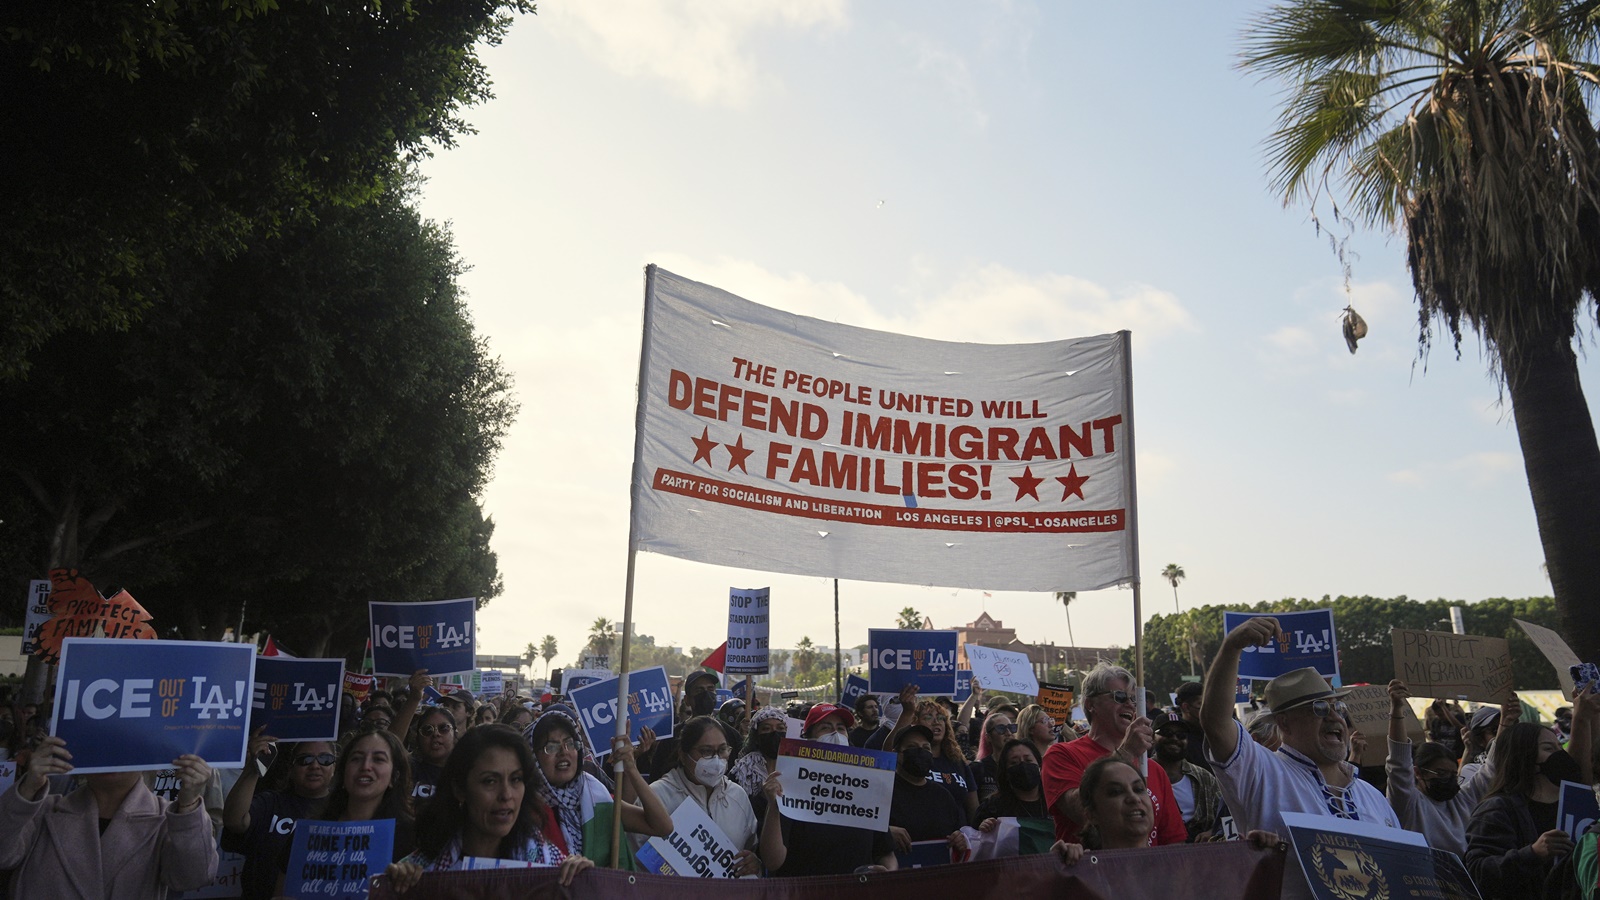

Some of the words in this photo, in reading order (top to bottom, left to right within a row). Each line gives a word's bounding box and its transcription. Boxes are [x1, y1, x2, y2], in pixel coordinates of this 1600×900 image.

[732, 357, 777, 387] THE
[782, 370, 872, 405] PEOPLE
[879, 389, 974, 418] UNITED
[981, 400, 1048, 419] WILL
[668, 369, 829, 441] DEFEND
[840, 410, 1122, 461] IMMIGRANT
[766, 441, 992, 500] FAMILIES!
[660, 473, 696, 491] PARTY
[698, 482, 719, 497] FOR
[722, 487, 782, 507] SOCIALISM
[785, 498, 809, 511] AND
[812, 502, 882, 520] LIBERATION
[896, 511, 920, 522] LOS
[924, 513, 983, 526] ANGELES
[994, 514, 1118, 528] @PSL_LOSANGELES
[66, 600, 141, 623] PROTECT
[730, 595, 753, 609] STOP
[755, 595, 769, 608] THE
[374, 624, 415, 649] ICE
[417, 625, 433, 637] OUT
[436, 621, 471, 649] LA!
[420, 637, 430, 649] OF
[727, 636, 752, 650] STOP
[755, 636, 768, 649] THE
[1280, 642, 1290, 654] OF
[1294, 629, 1331, 654] LA!
[1402, 631, 1480, 659] PROTECT
[872, 648, 911, 670] ICE
[913, 649, 927, 660] OUT
[927, 648, 955, 672] LA!
[915, 660, 924, 671] OF
[1404, 661, 1476, 683] MIGRANTS
[159, 678, 186, 698] OUT
[270, 683, 289, 697] OUT
[845, 683, 867, 698] ICE
[957, 679, 970, 690] CE
[63, 678, 154, 720] ICE
[189, 676, 246, 720] LA!
[271, 697, 284, 711] OF
[291, 682, 337, 712] LA!
[639, 686, 670, 713] LA!
[1043, 696, 1068, 707] Trump
[161, 698, 180, 718] OF
[631, 704, 641, 715] OF
[1040, 705, 1068, 714] ascist
[811, 748, 860, 765] SOLIDARIDAD
[859, 756, 875, 767] POR
[798, 767, 870, 789] Derechos
[810, 784, 830, 797] de
[831, 786, 854, 801] los
[268, 814, 298, 835] IC
[309, 825, 319, 834] WE
[318, 826, 330, 835] ARE
[331, 825, 375, 835] CALIFORNIA
[1564, 813, 1596, 843] IC
[307, 834, 340, 852] COME
[343, 835, 370, 852] FOR
[1315, 832, 1363, 849] AMGLA
[306, 850, 329, 863] one
[330, 848, 347, 866] of
[302, 863, 338, 881] COME
[341, 863, 368, 880] FOR
[300, 878, 323, 894] all
[323, 879, 340, 896] of
[342, 877, 365, 894] us!
